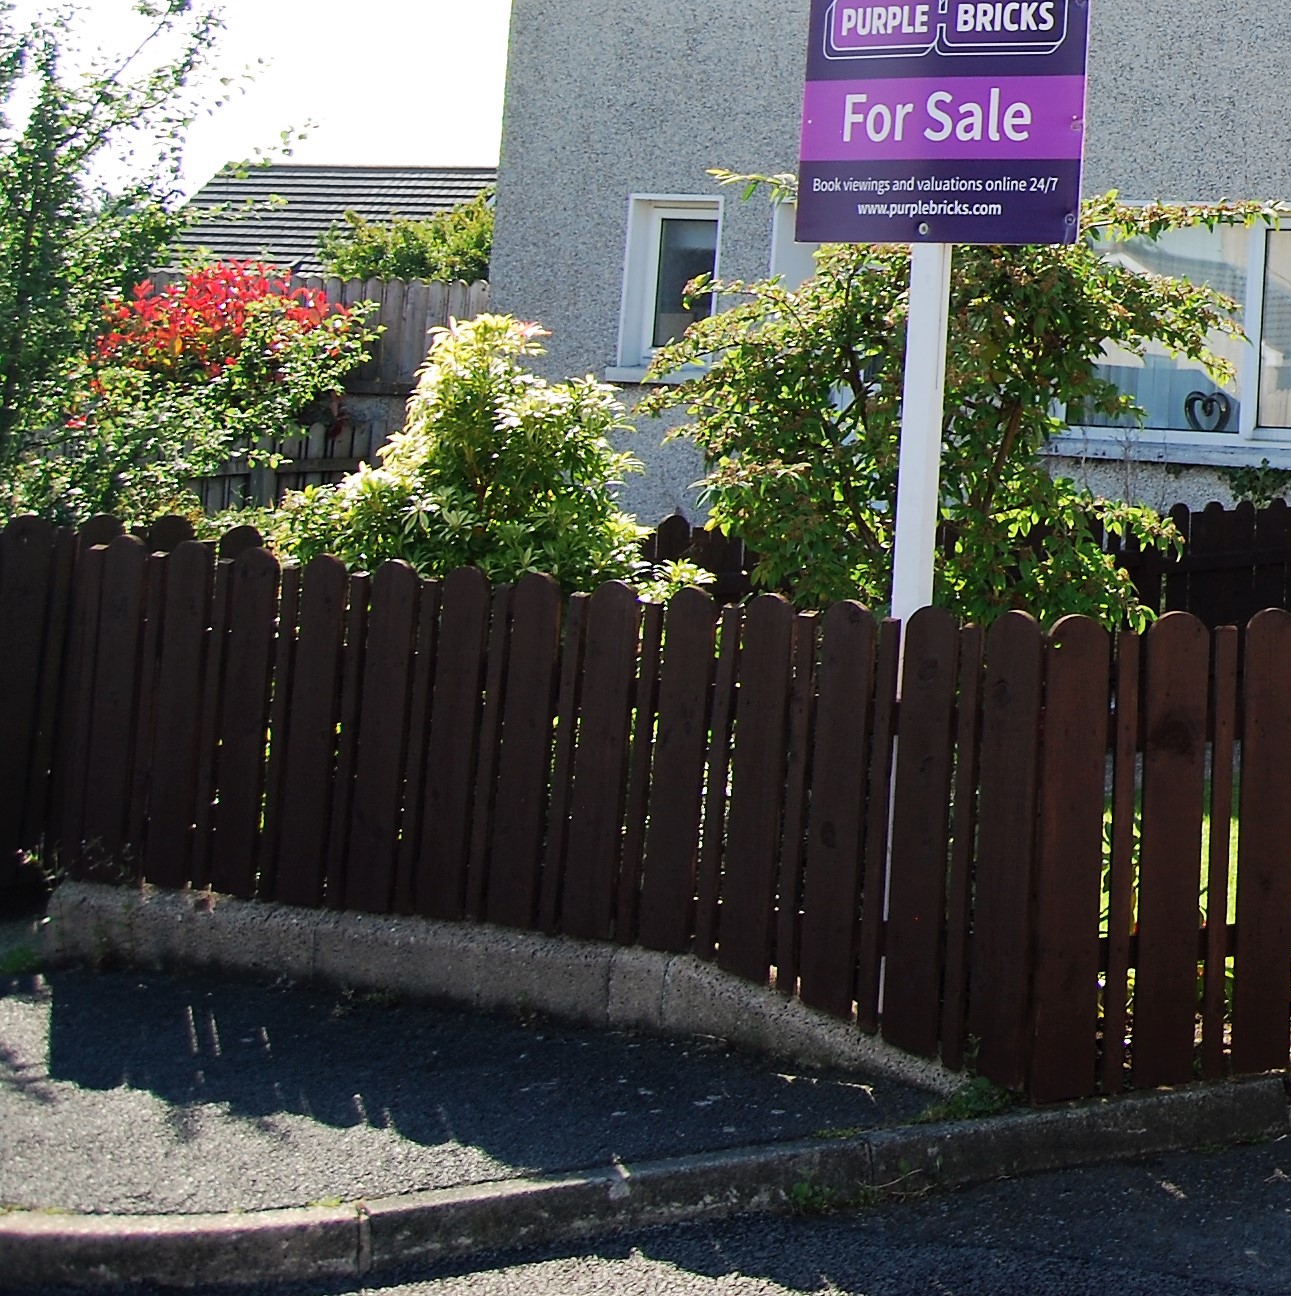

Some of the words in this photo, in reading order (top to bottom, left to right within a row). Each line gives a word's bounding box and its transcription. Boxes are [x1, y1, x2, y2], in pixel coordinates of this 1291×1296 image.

[841, 5, 930, 36] PURPLE
[956, 1, 1054, 33] BRICKS
[842, 93, 914, 143] For
[923, 87, 1032, 142] Sale
[813, 177, 841, 192] Book
[843, 177, 890, 195] viewings
[892, 176, 915, 191] and
[917, 176, 983, 192] valuations
[985, 176, 1027, 192] online
[1029, 176, 1059, 194] 24/7
[857, 200, 1002, 218] www.purplebricks.com
